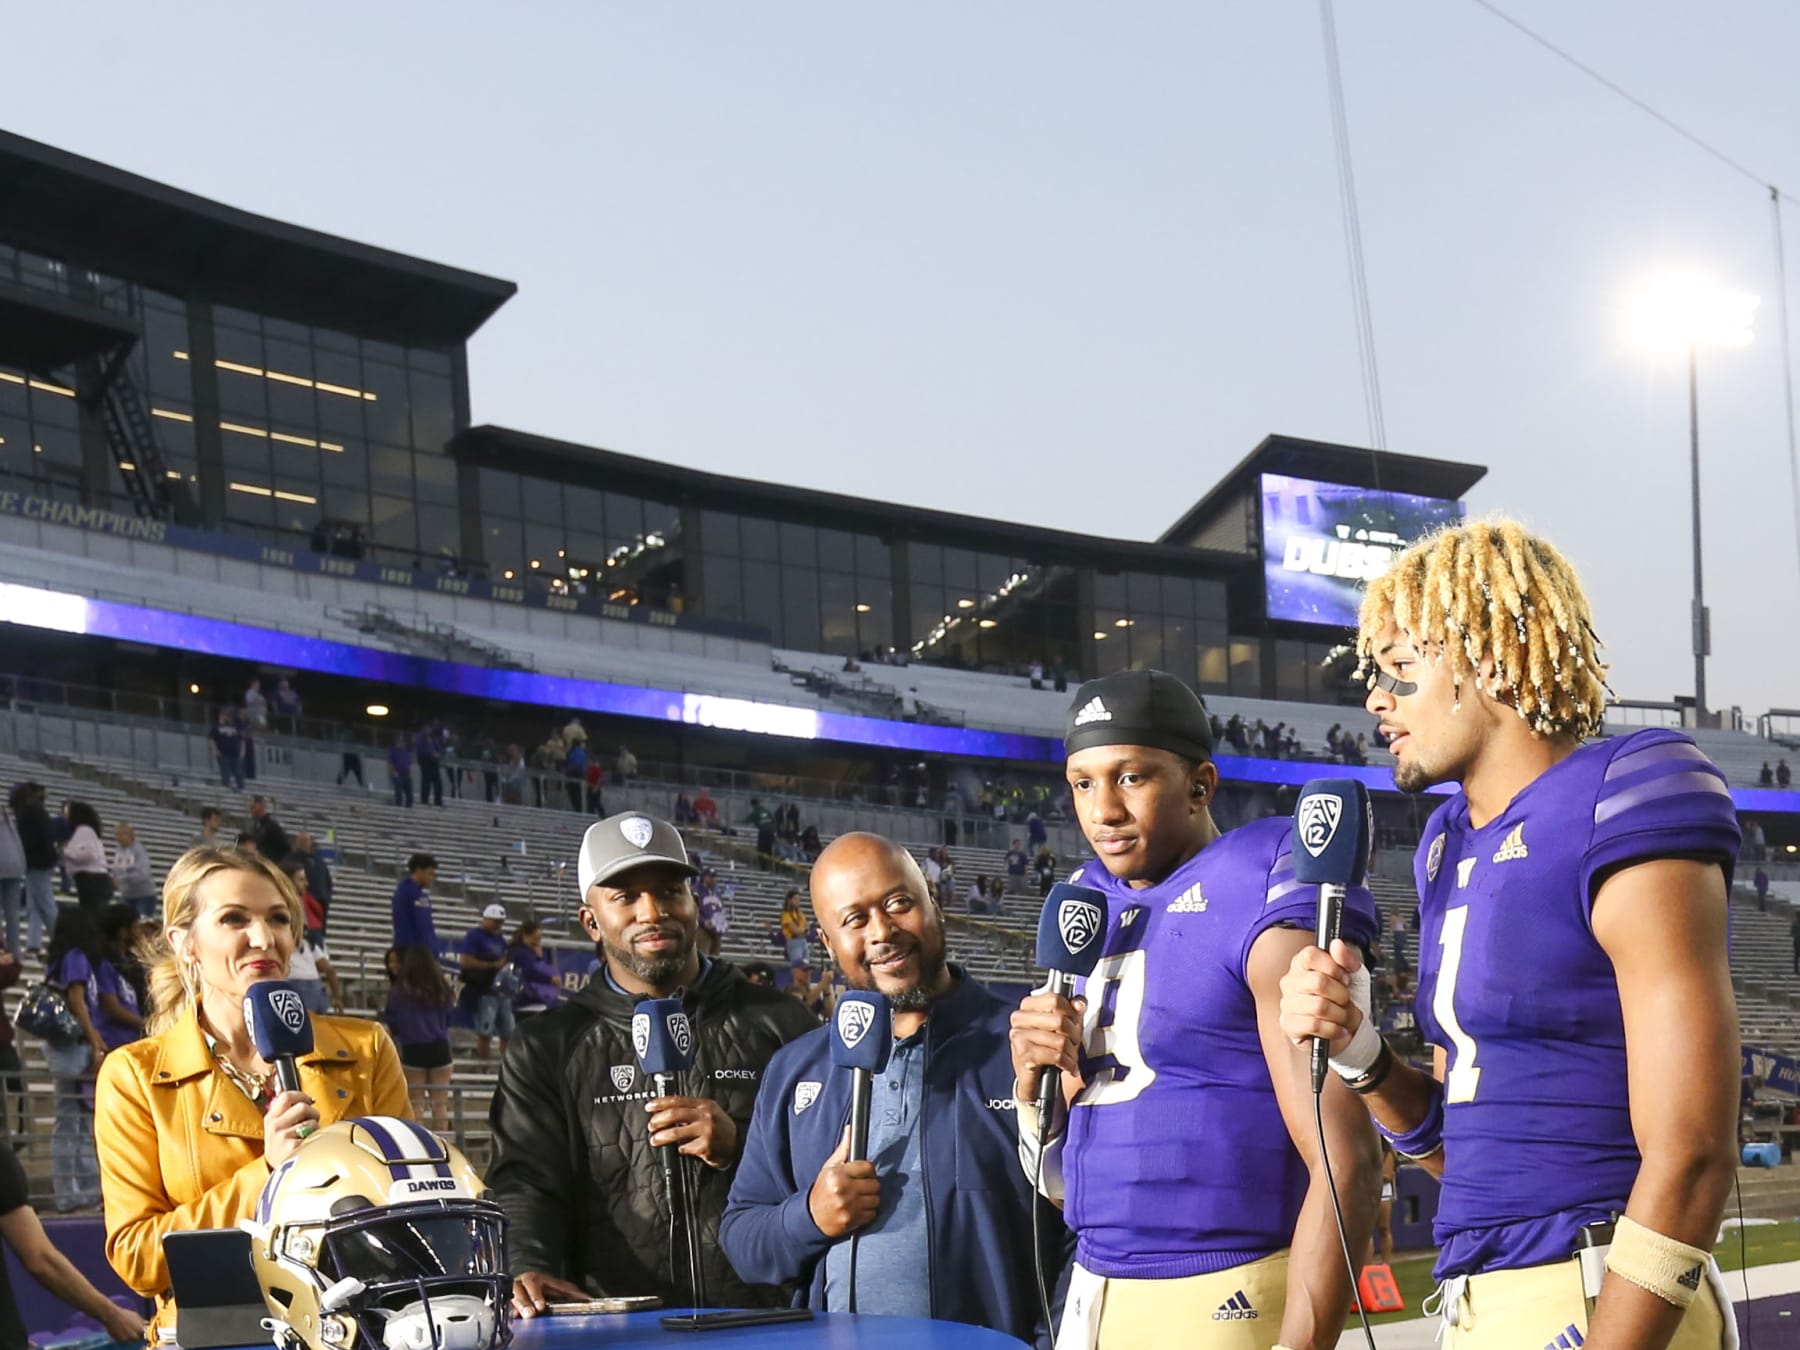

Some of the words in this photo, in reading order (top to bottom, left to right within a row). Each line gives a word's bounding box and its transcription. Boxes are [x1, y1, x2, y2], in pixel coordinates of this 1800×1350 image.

[23, 495, 166, 542] CHAMPIONS
[1308, 826, 1325, 845] 12
[1068, 928, 1087, 945] 12
[1432, 904, 1482, 1104] 1
[286, 1011, 301, 1026] 12
[844, 1023, 860, 1040] 12
[706, 1068, 756, 1080] OCKEY
[594, 1090, 657, 1105] NETWORKS
[1211, 1308, 1258, 1320] adidas
